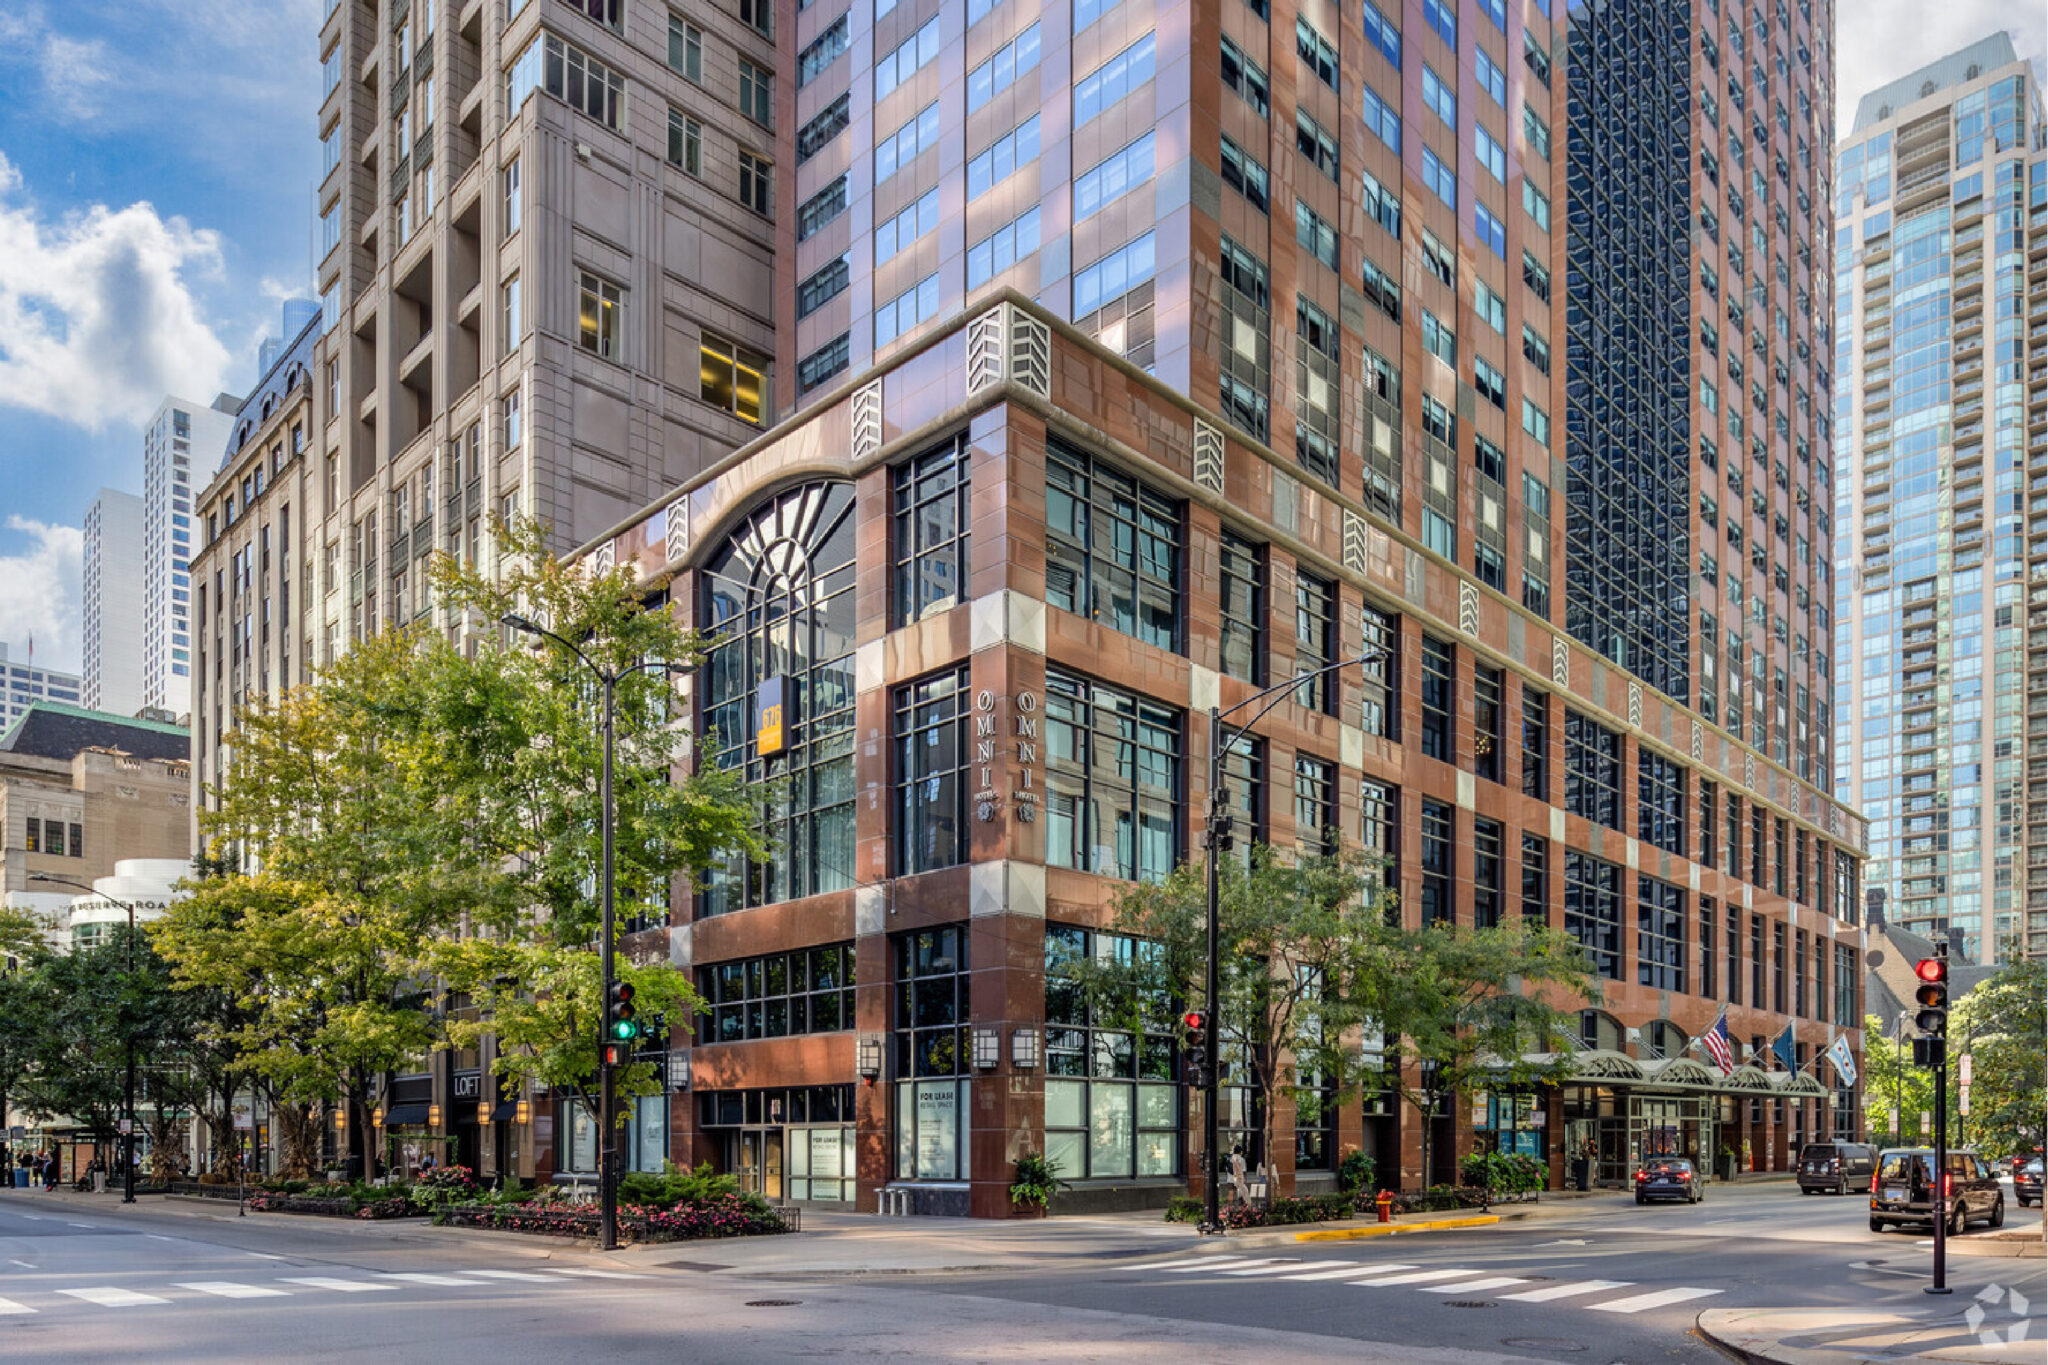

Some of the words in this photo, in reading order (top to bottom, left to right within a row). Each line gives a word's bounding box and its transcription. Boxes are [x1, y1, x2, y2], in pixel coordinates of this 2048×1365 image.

[763, 703, 782, 730] 676
[977, 689, 996, 789] OMNI
[1016, 691, 1037, 789] OMNI
[454, 1076, 480, 1096] LOFT
[920, 1092, 933, 1101] FOR
[934, 1091, 953, 1101] LEASE
